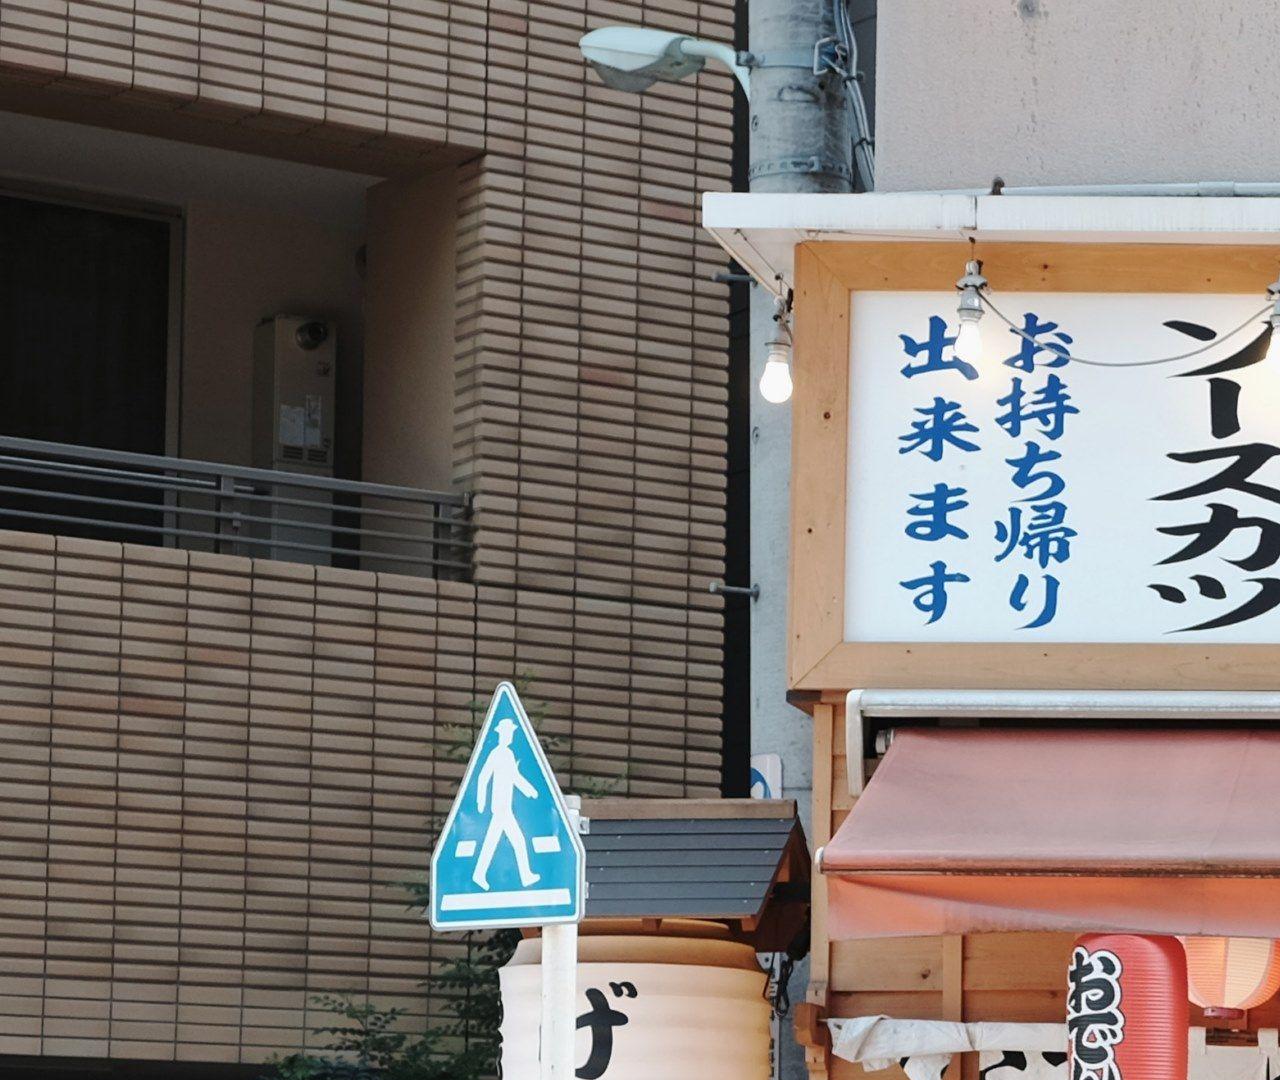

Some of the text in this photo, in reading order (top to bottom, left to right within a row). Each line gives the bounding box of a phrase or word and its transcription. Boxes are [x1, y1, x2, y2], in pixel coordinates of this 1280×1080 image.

[897, 315, 982, 627] 出来ます
[994, 312, 1081, 629] お持ち帰り
